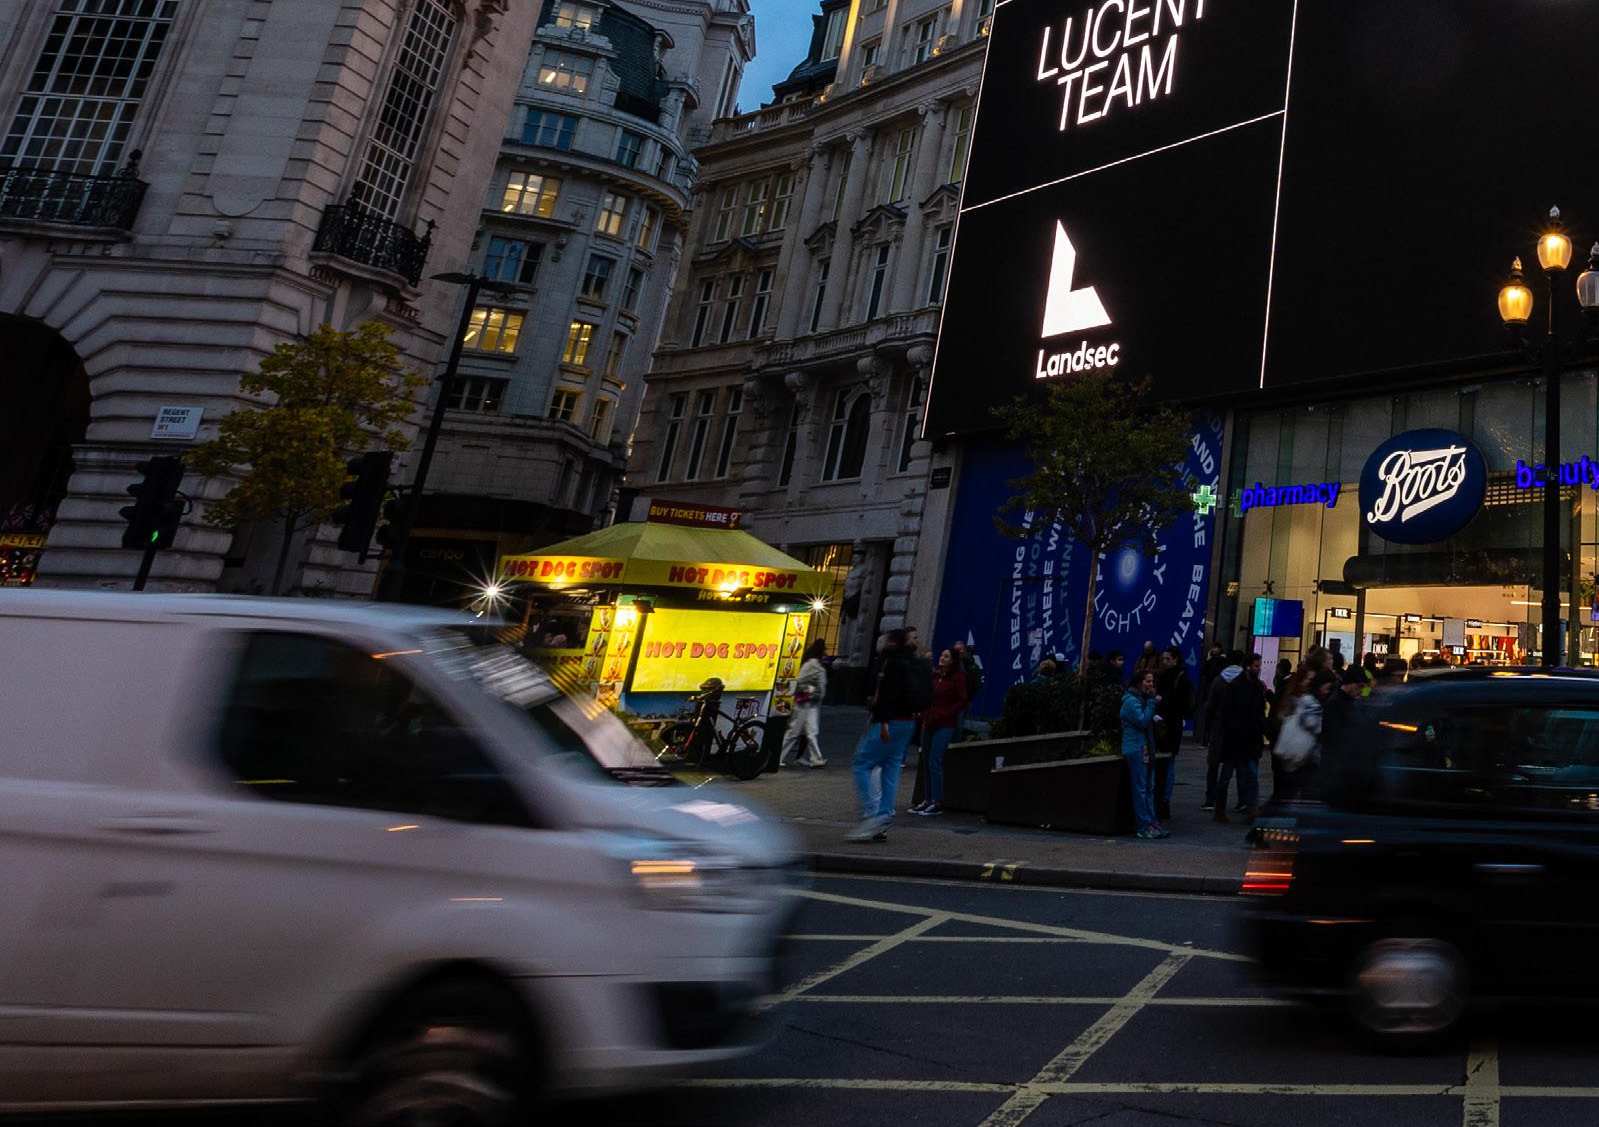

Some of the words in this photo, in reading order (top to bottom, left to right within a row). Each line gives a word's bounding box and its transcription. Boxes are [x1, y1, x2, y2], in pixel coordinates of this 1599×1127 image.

[1057, 33, 1178, 132] TEAM
[1036, 341, 1120, 379] Landsec
[1241, 482, 1340, 514] pharmacy
[1367, 445, 1467, 524] Boots
[649, 506, 669, 516] BUY
[669, 508, 704, 520] TICKETS
[705, 512, 728, 522] HERE
[504, 560, 539, 577] HOT
[541, 561, 577, 578] DOG
[580, 562, 624, 579] SPOT
[669, 565, 709, 584] HOT
[712, 569, 750, 586] DOG
[753, 571, 798, 589] SPOT
[1011, 546, 1026, 650] BEATING
[1043, 560, 1054, 645] THERE
[1094, 589, 1157, 634] LIGHTS
[645, 641, 687, 659] HOT
[690, 642, 729, 659] DOG
[734, 643, 778, 659] SPOT
[1372, 643, 1388, 654] DIOR
